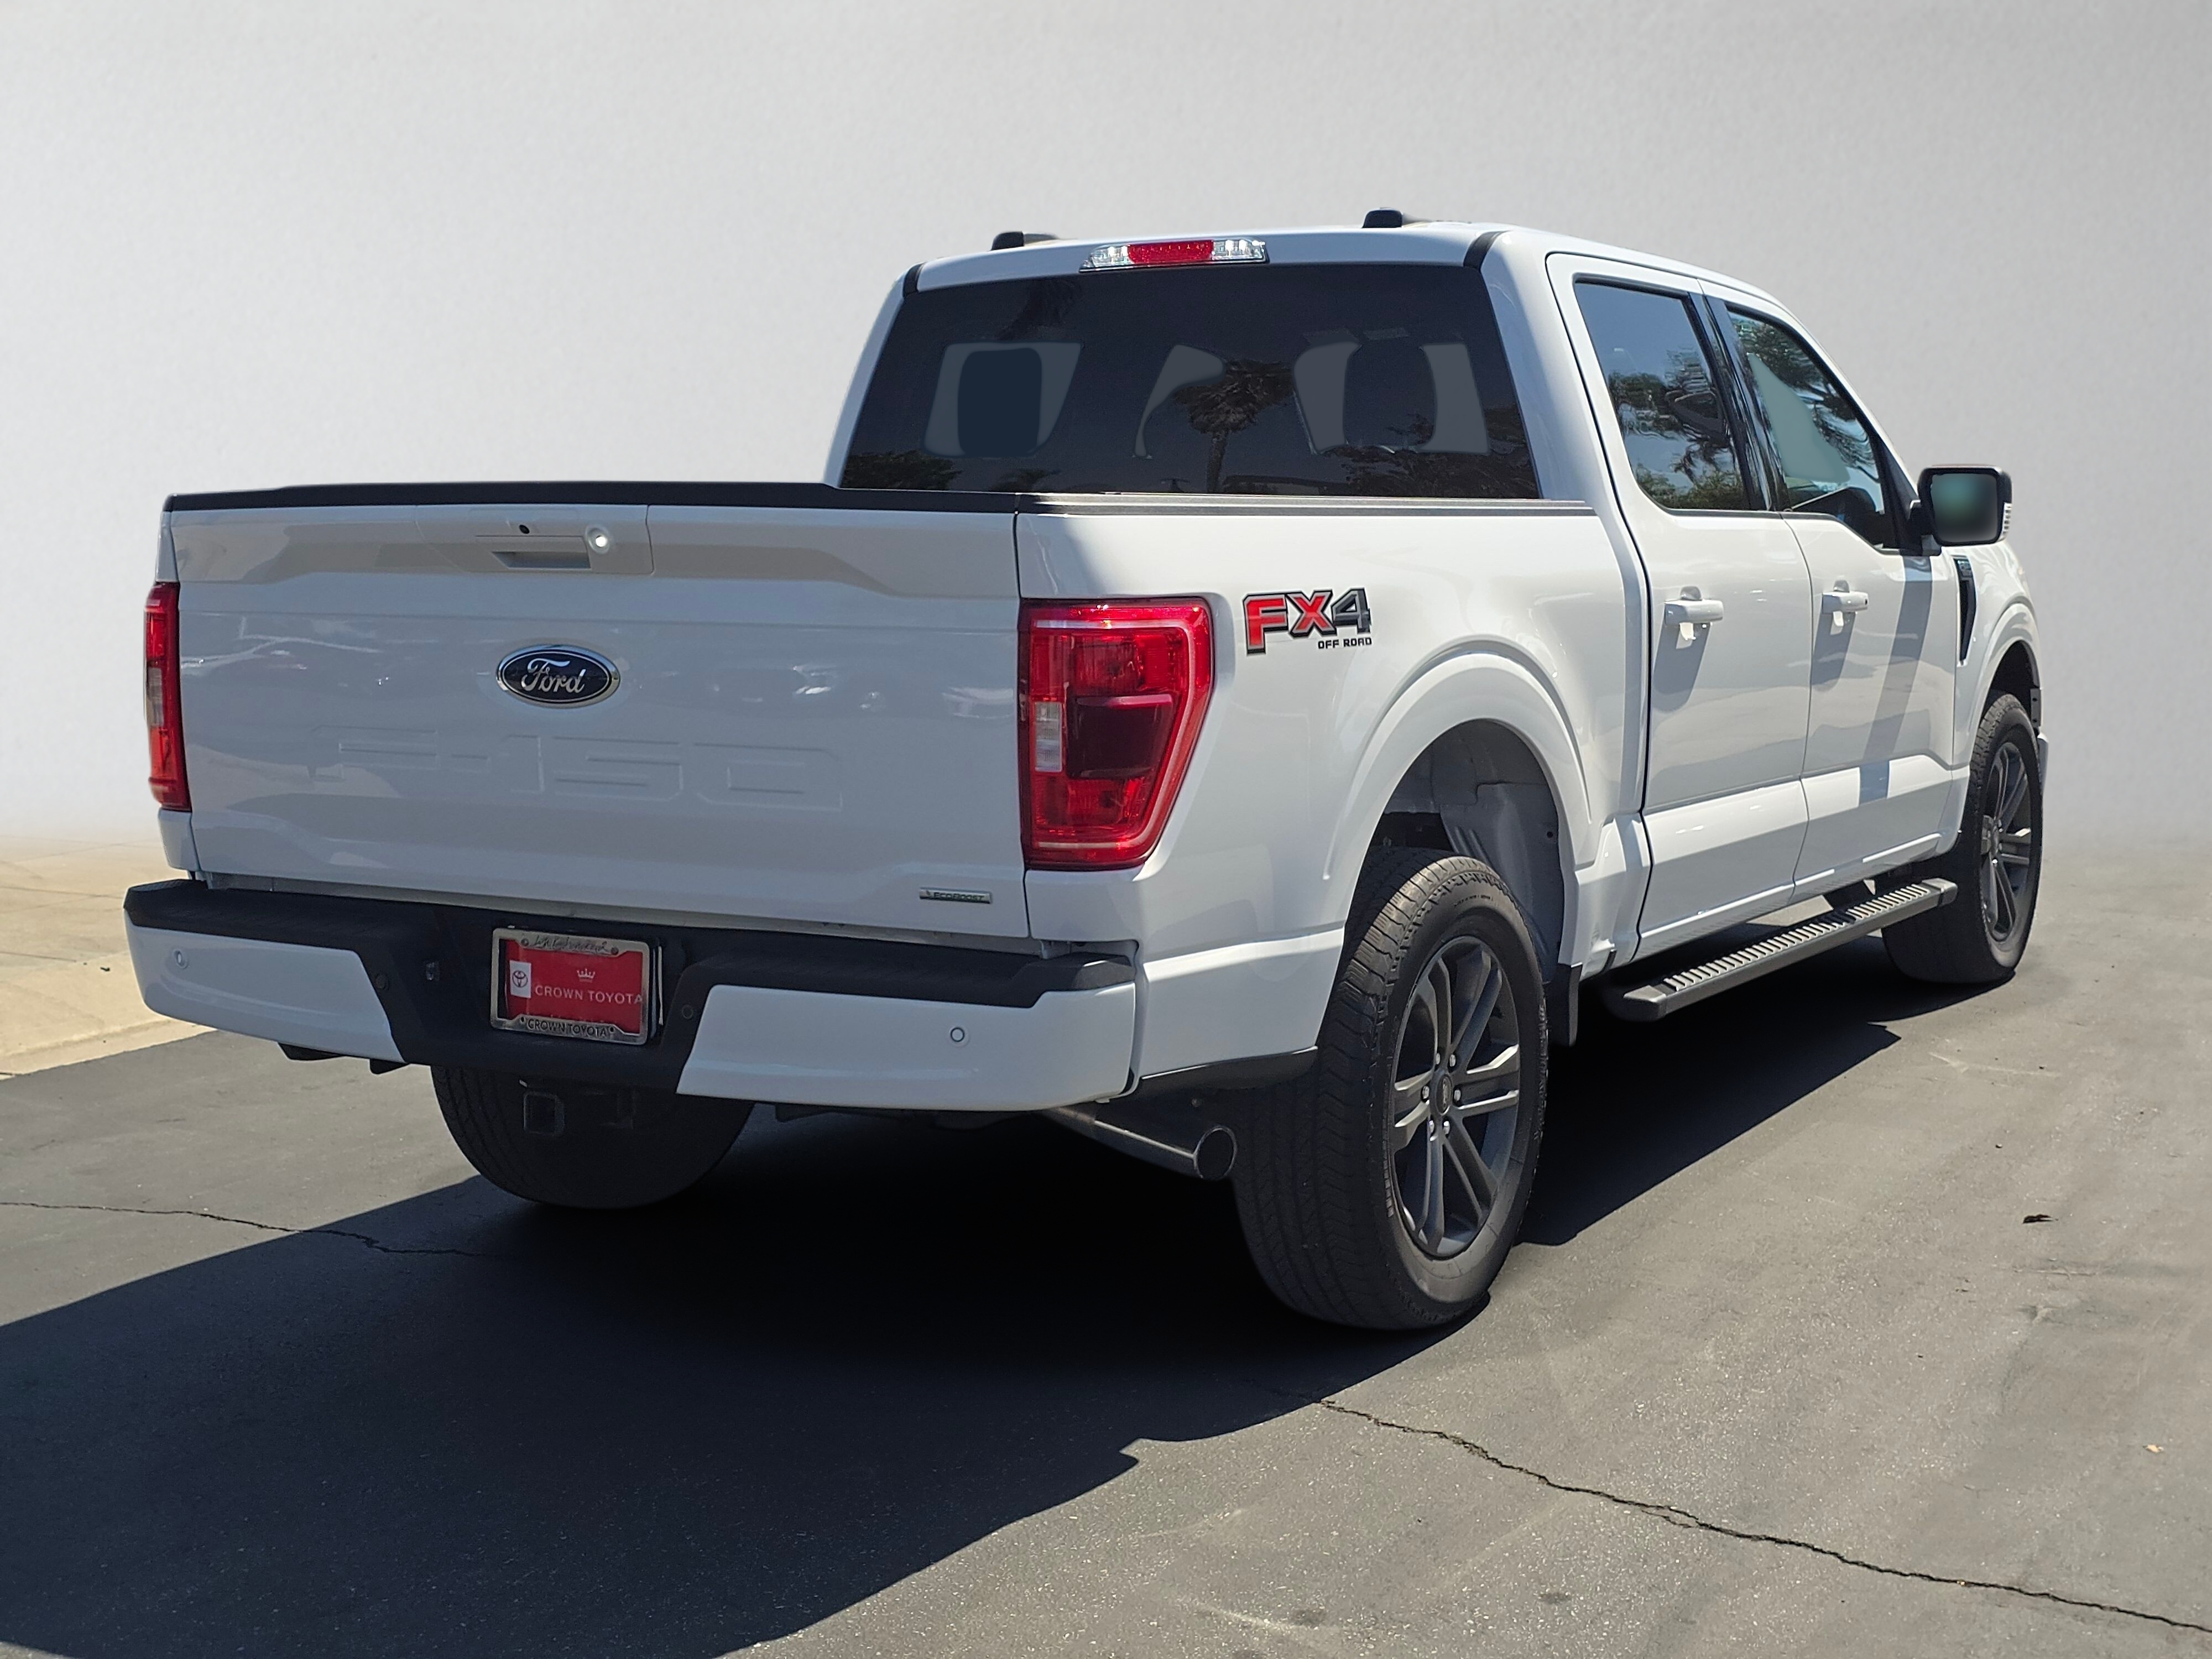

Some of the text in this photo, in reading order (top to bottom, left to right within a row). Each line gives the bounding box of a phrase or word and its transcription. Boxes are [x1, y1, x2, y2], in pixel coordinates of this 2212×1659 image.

[1243, 587, 1371, 655] FX4
[1318, 637, 1372, 649] OFF ROAD
[521, 658, 587, 693] Ford
[311, 724, 842, 811] F-150
[535, 985, 643, 1005] CROWN TOYOTA
[528, 1019, 607, 1037] CROWN TOYOTA
